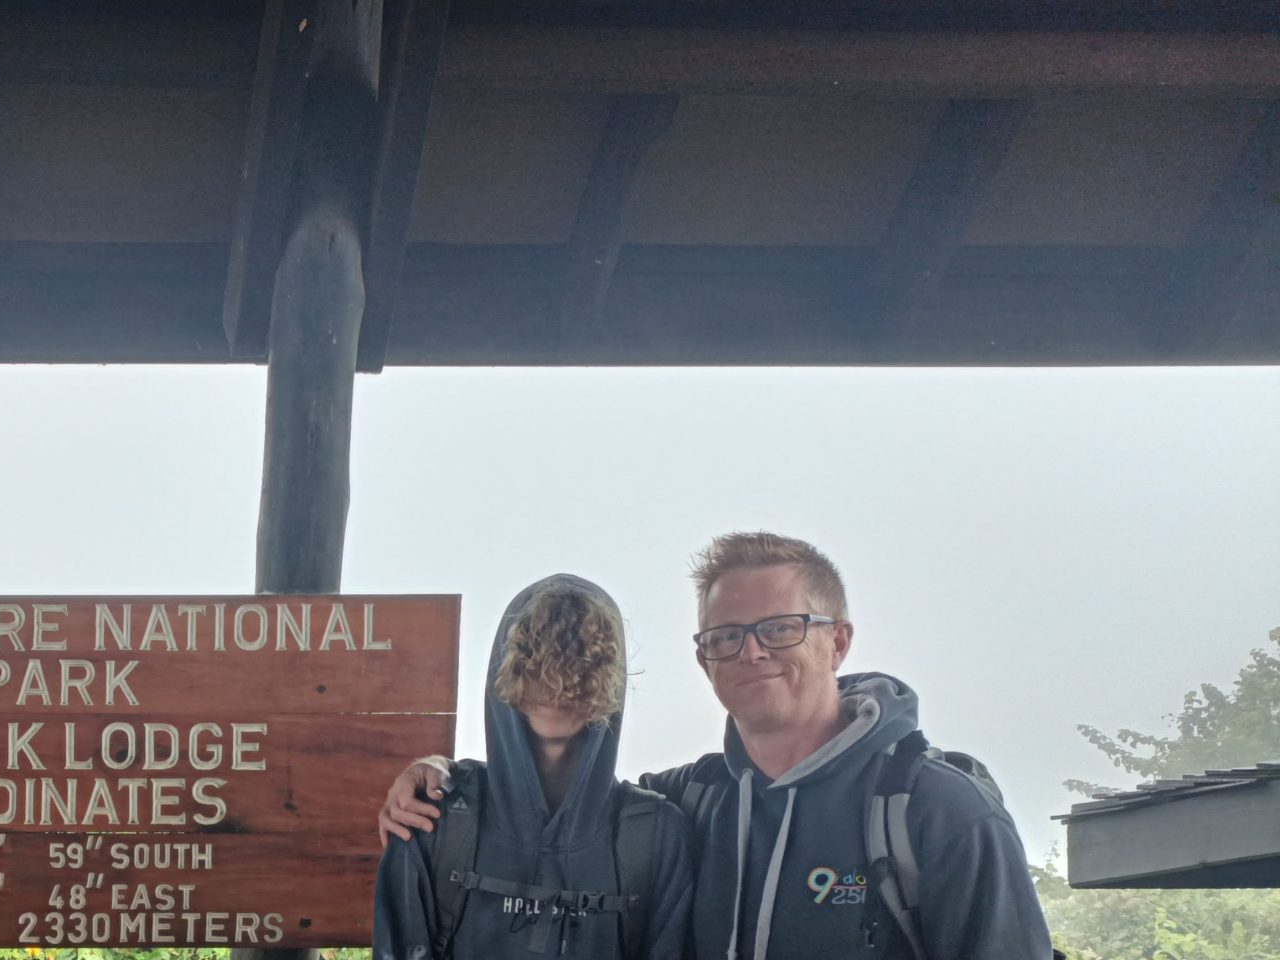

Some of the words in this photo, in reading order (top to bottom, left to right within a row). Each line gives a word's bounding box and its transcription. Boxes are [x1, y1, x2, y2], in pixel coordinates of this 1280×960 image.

[93, 602, 393, 651] NATIONAL
[64, 722, 268, 770] LODGE
[111, 842, 213, 869] SOUTH
[112, 884, 196, 910] EAST
[19, 912, 111, 944] 2330
[120, 913, 283, 943] METERS
